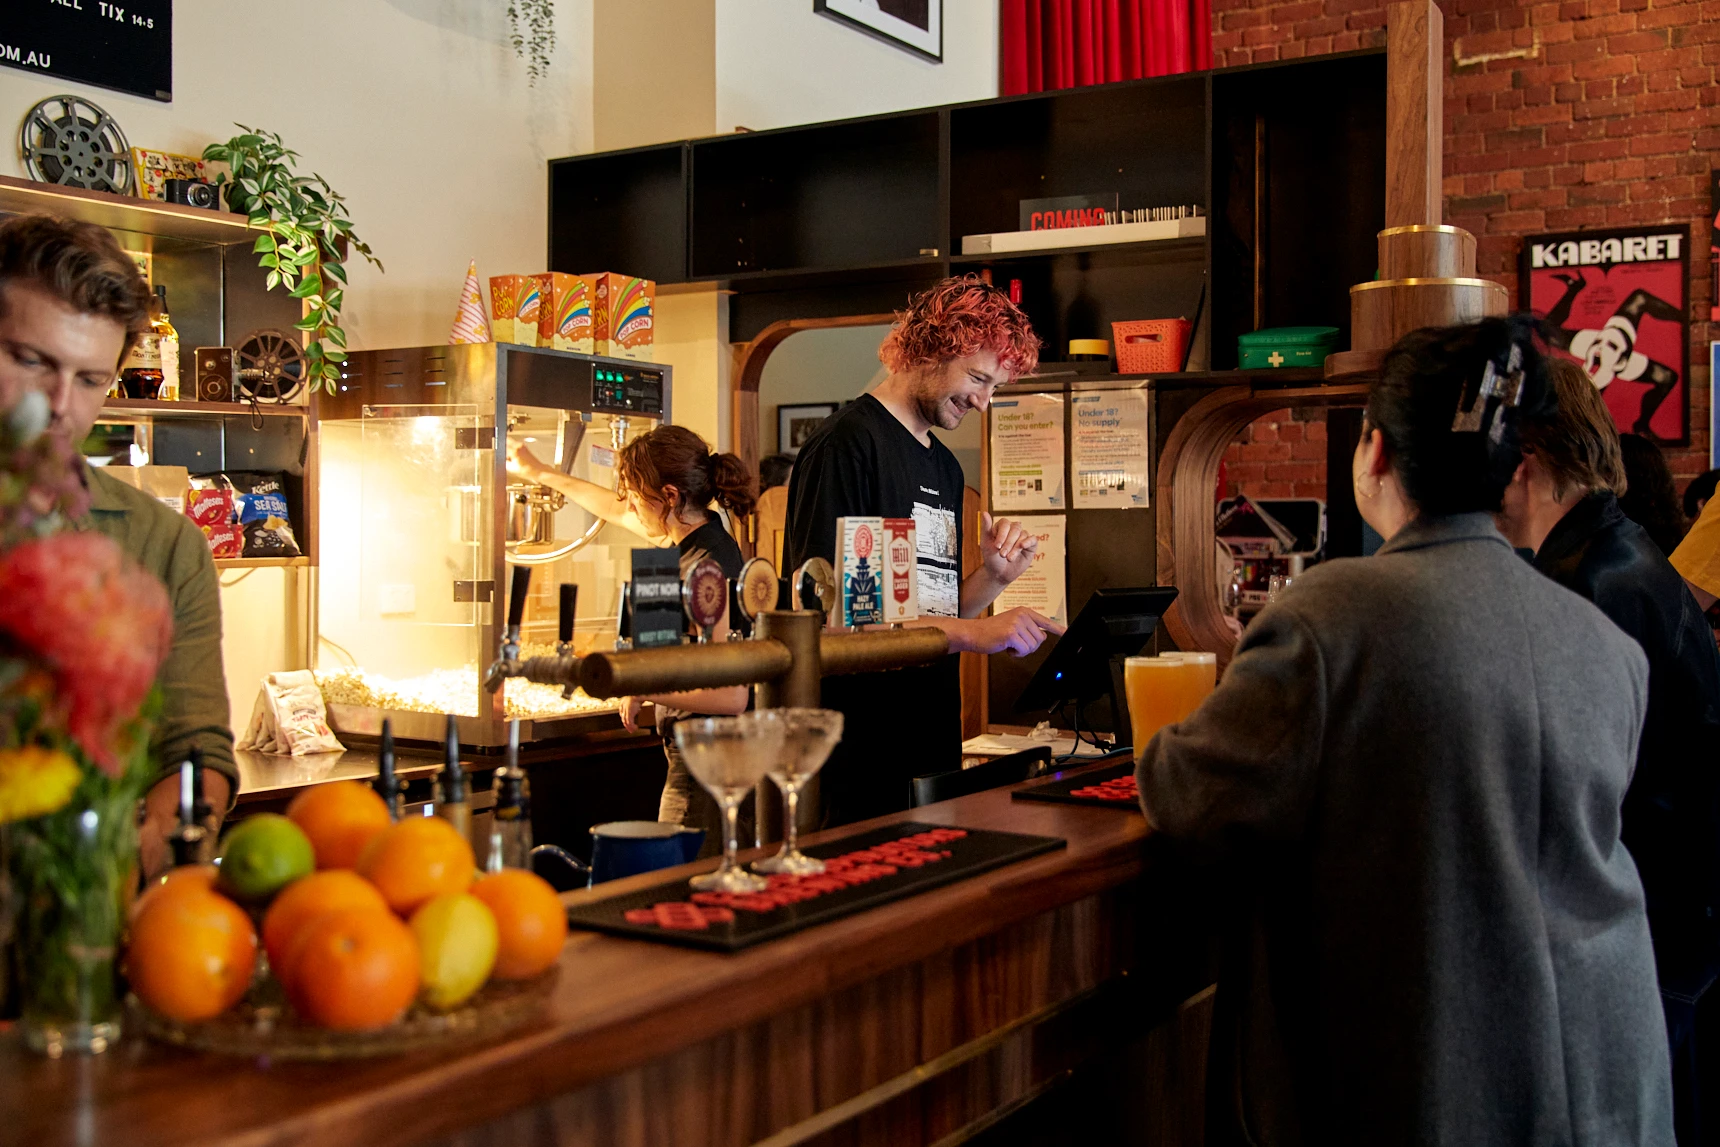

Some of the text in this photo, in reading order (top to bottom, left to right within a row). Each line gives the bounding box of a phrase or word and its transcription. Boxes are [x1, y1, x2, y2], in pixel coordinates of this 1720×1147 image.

[98, 2, 124, 22] TIX
[1531, 233, 1683, 268] KABARET
[563, 318, 589, 333] POP CORN
[620, 318, 648, 338] POP CORN
[998, 412, 1034, 422] Under 18?
[1078, 407, 1119, 417] Under 18?
[998, 420, 1053, 432] Can you enter?
[252, 481, 280, 494] Kettle
[254, 500, 271, 511] SEA
[636, 583, 659, 598] PINOT
[853, 602, 874, 611] PALE ALE
